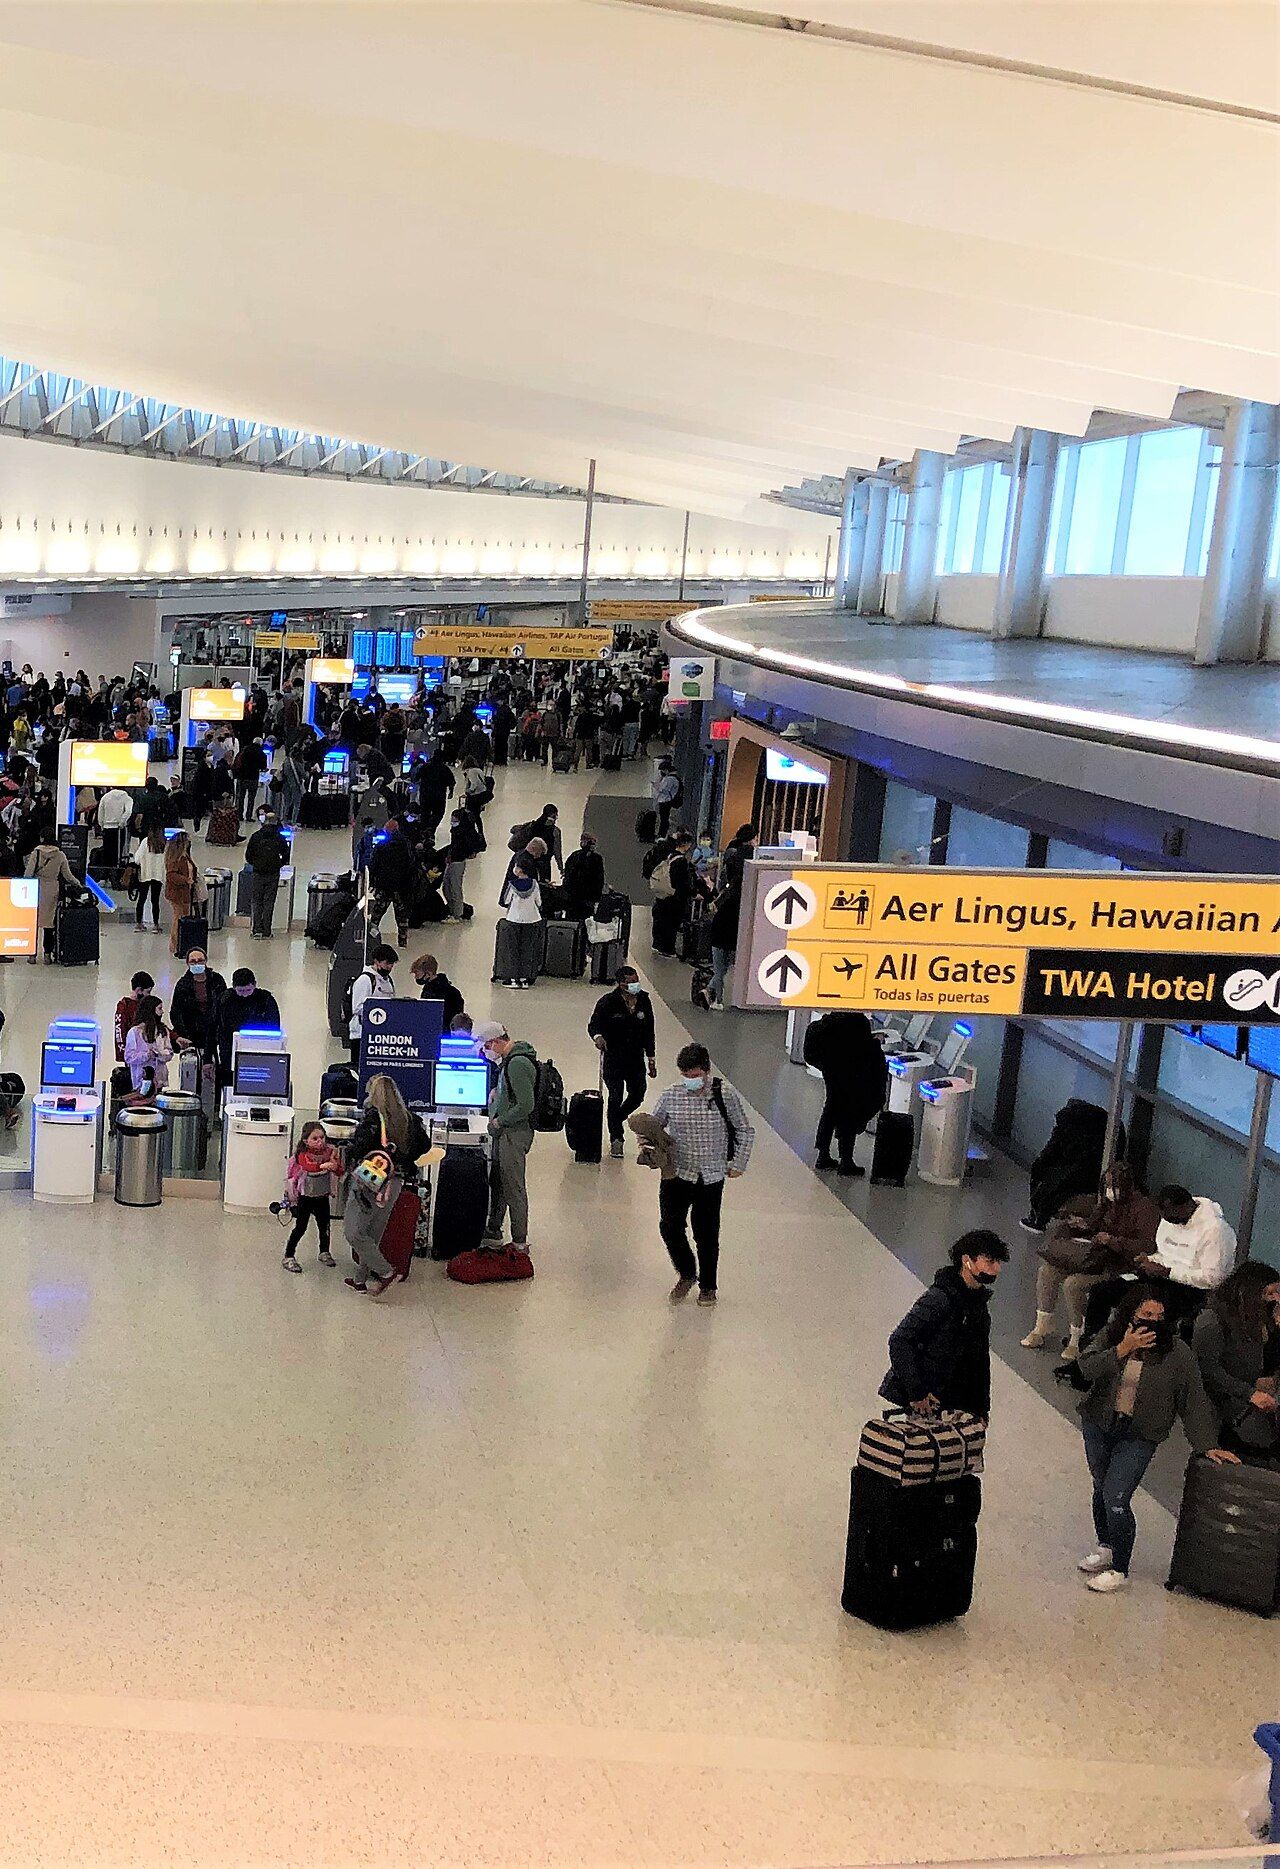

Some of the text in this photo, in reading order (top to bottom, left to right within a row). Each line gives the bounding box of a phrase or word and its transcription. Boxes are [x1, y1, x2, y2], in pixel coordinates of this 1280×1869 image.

[578, 633, 610, 642] Portugal
[21, 886, 28, 899] 1
[880, 895, 944, 922] Aer
[954, 896, 1077, 932] Lingus,
[1091, 901, 1260, 933] Hawaiian
[874, 953, 1016, 984] All Gates
[1040, 969, 1216, 1002] TWA Hotel
[873, 988, 990, 1005] Todas las puertas
[368, 1034, 413, 1045] LONDON
[367, 1046, 419, 1057] CHECK-IN
